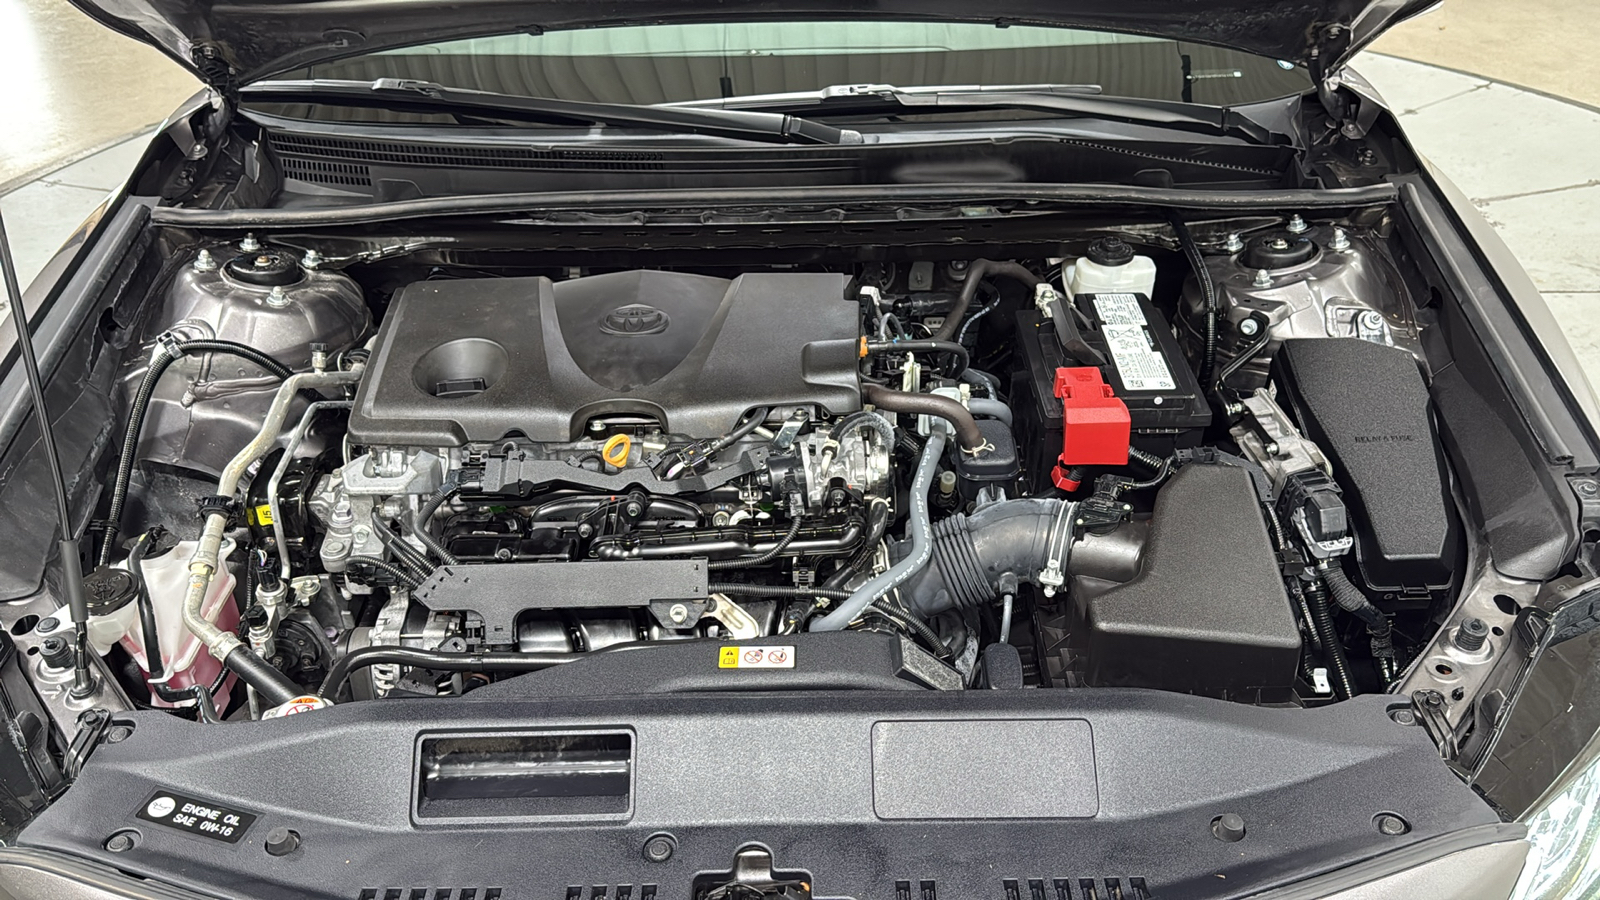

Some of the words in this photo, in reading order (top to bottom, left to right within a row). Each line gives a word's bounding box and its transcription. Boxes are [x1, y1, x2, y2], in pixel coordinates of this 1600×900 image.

[172, 813, 197, 827] SAE
[199, 821, 234, 837] 0W-16
[181, 803, 221, 820] ENGINE
[223, 814, 241, 826] OIL
